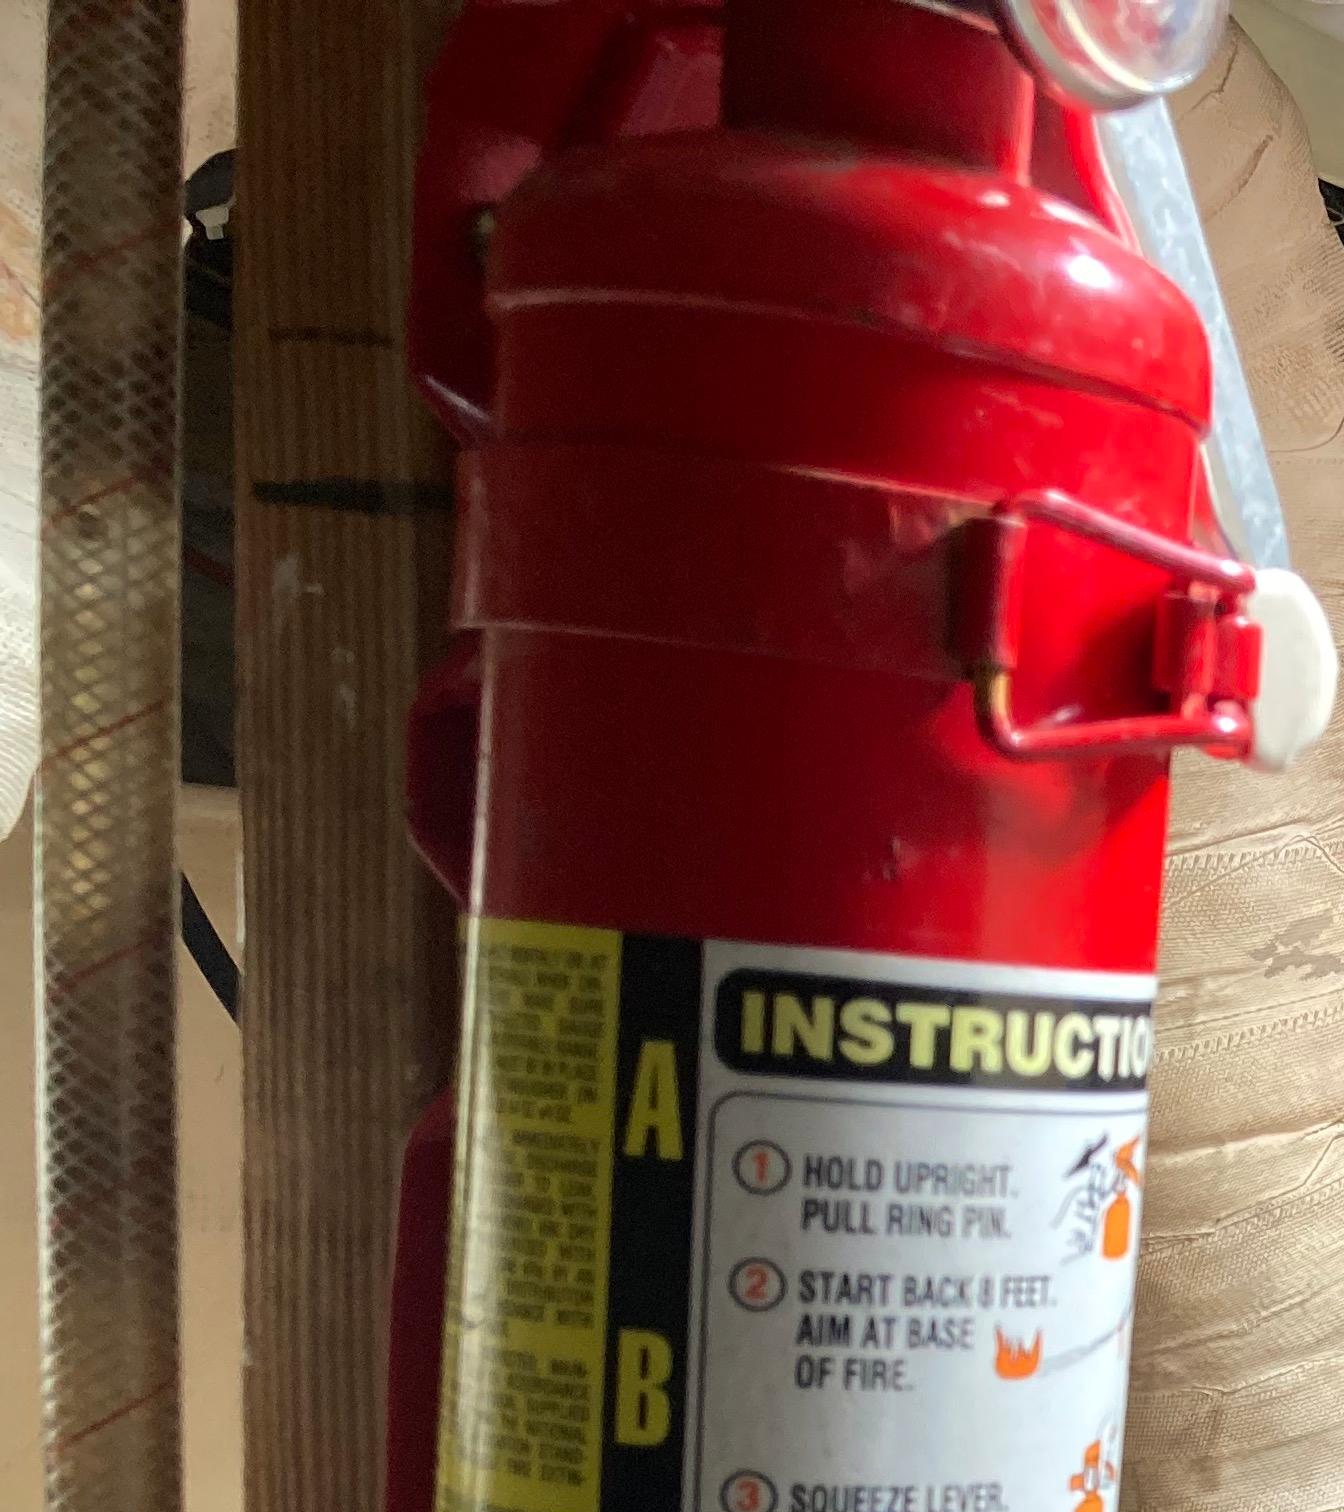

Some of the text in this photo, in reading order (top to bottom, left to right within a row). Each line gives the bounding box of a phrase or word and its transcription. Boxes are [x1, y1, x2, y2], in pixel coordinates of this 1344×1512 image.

[623, 1039, 684, 1163] A
[803, 1155, 882, 1191] HOLD
[894, 1161, 1019, 1198] UPRIGHT.
[801, 1196, 1012, 1239] PULL RING PIN.
[799, 1270, 893, 1306] START
[904, 1274, 974, 1308] BACK
[999, 1275, 1057, 1309] FEET.
[795, 1314, 976, 1351] AIM AT BASE
[614, 1327, 674, 1447] B
[794, 1354, 916, 1391] OF FIRE.
